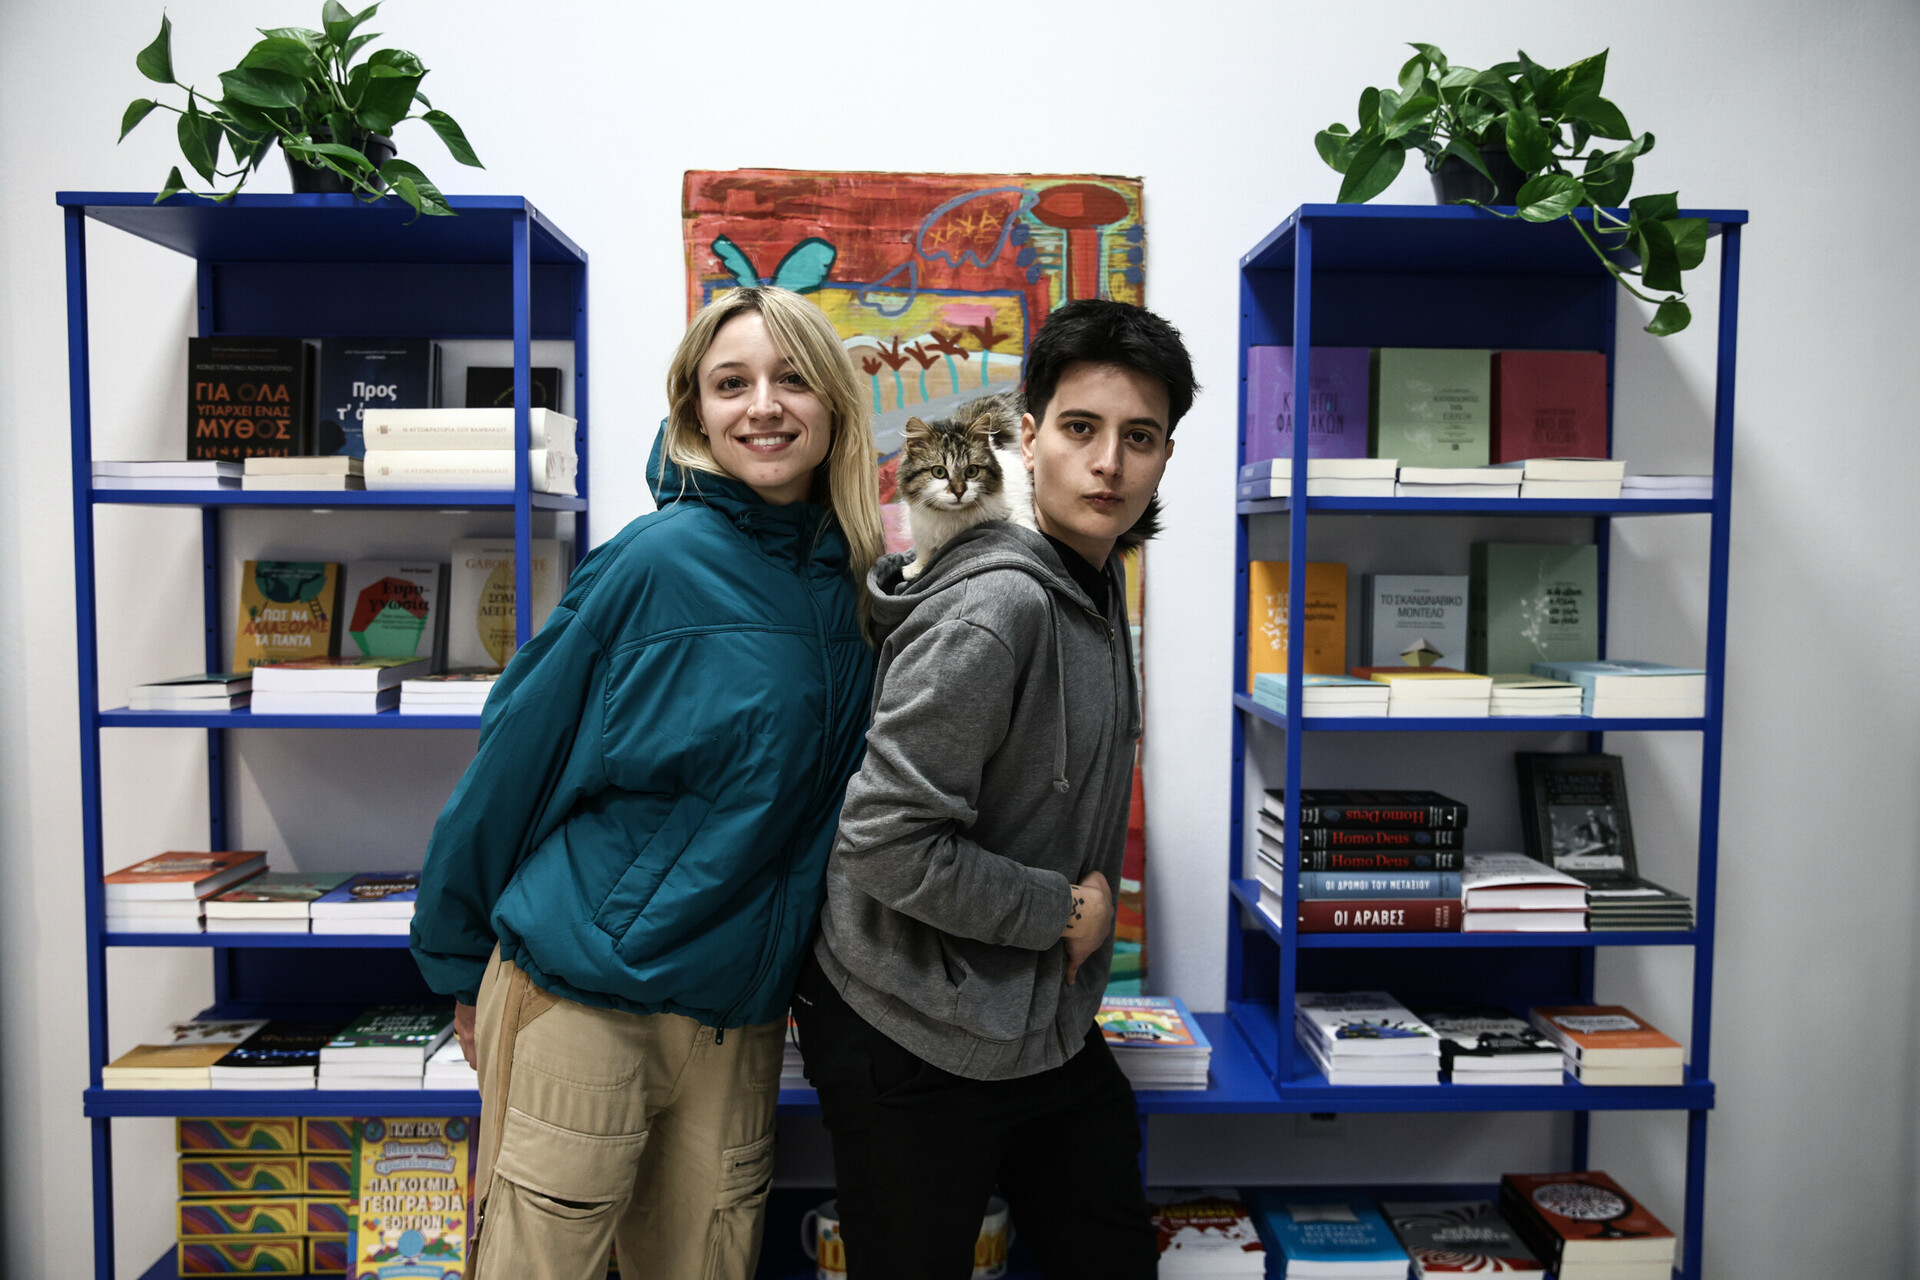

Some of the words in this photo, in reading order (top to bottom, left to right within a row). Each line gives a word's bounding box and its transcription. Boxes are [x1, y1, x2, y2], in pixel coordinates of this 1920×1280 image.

[196, 382, 230, 402] ΓΙΑ
[238, 383, 290, 402] ΟΛΑ
[352, 381, 398, 401] Προς
[196, 405, 252, 417] ΥΠΑΡΧΕΙ
[255, 405, 291, 417] ΕΝΑΣ
[196, 418, 291, 440] ΜΥΘΟΣ
[1276, 413, 1344, 434] ΦΑΑΚΩΝ
[465, 558, 510, 569] GABOR
[489, 593, 516, 603] ΣΩΜ
[1381, 595, 1393, 605] ΤΟ
[1394, 595, 1462, 606] ΣΚΑΝΔΙΝΑΒΙΚΟ
[262, 608, 288, 622] ΠΩΣ
[291, 610, 308, 622] ΝΑ
[1397, 607, 1444, 618] ΜΟΝΤΕΛΟ
[255, 633, 269, 647] ΤΑ
[272, 633, 312, 648] ΠΑΝΤΑ
[1345, 809, 1379, 823] Deus
[1382, 810, 1425, 823] Homo
[1332, 831, 1374, 844] Homo
[1376, 831, 1410, 844] Deus
[1332, 854, 1374, 867] Homo
[1376, 854, 1410, 867] Deus
[1325, 880, 1335, 891] ΟΙ
[1337, 880, 1369, 891] ΔΡΟΜΟΙ
[1371, 880, 1387, 891] ΤΟΥ
[1390, 879, 1431, 891] ΜΕΤΑΞΙΟΥ
[1334, 910, 1349, 926] ΟΙ
[1353, 909, 1405, 926] ΑΡΑΒΕΣ
[369, 1177, 458, 1193] ΠΑΓΚΟΣΜΙΑ
[361, 1194, 465, 1213] ΓΕΩΓΡΑΦΙΑ
